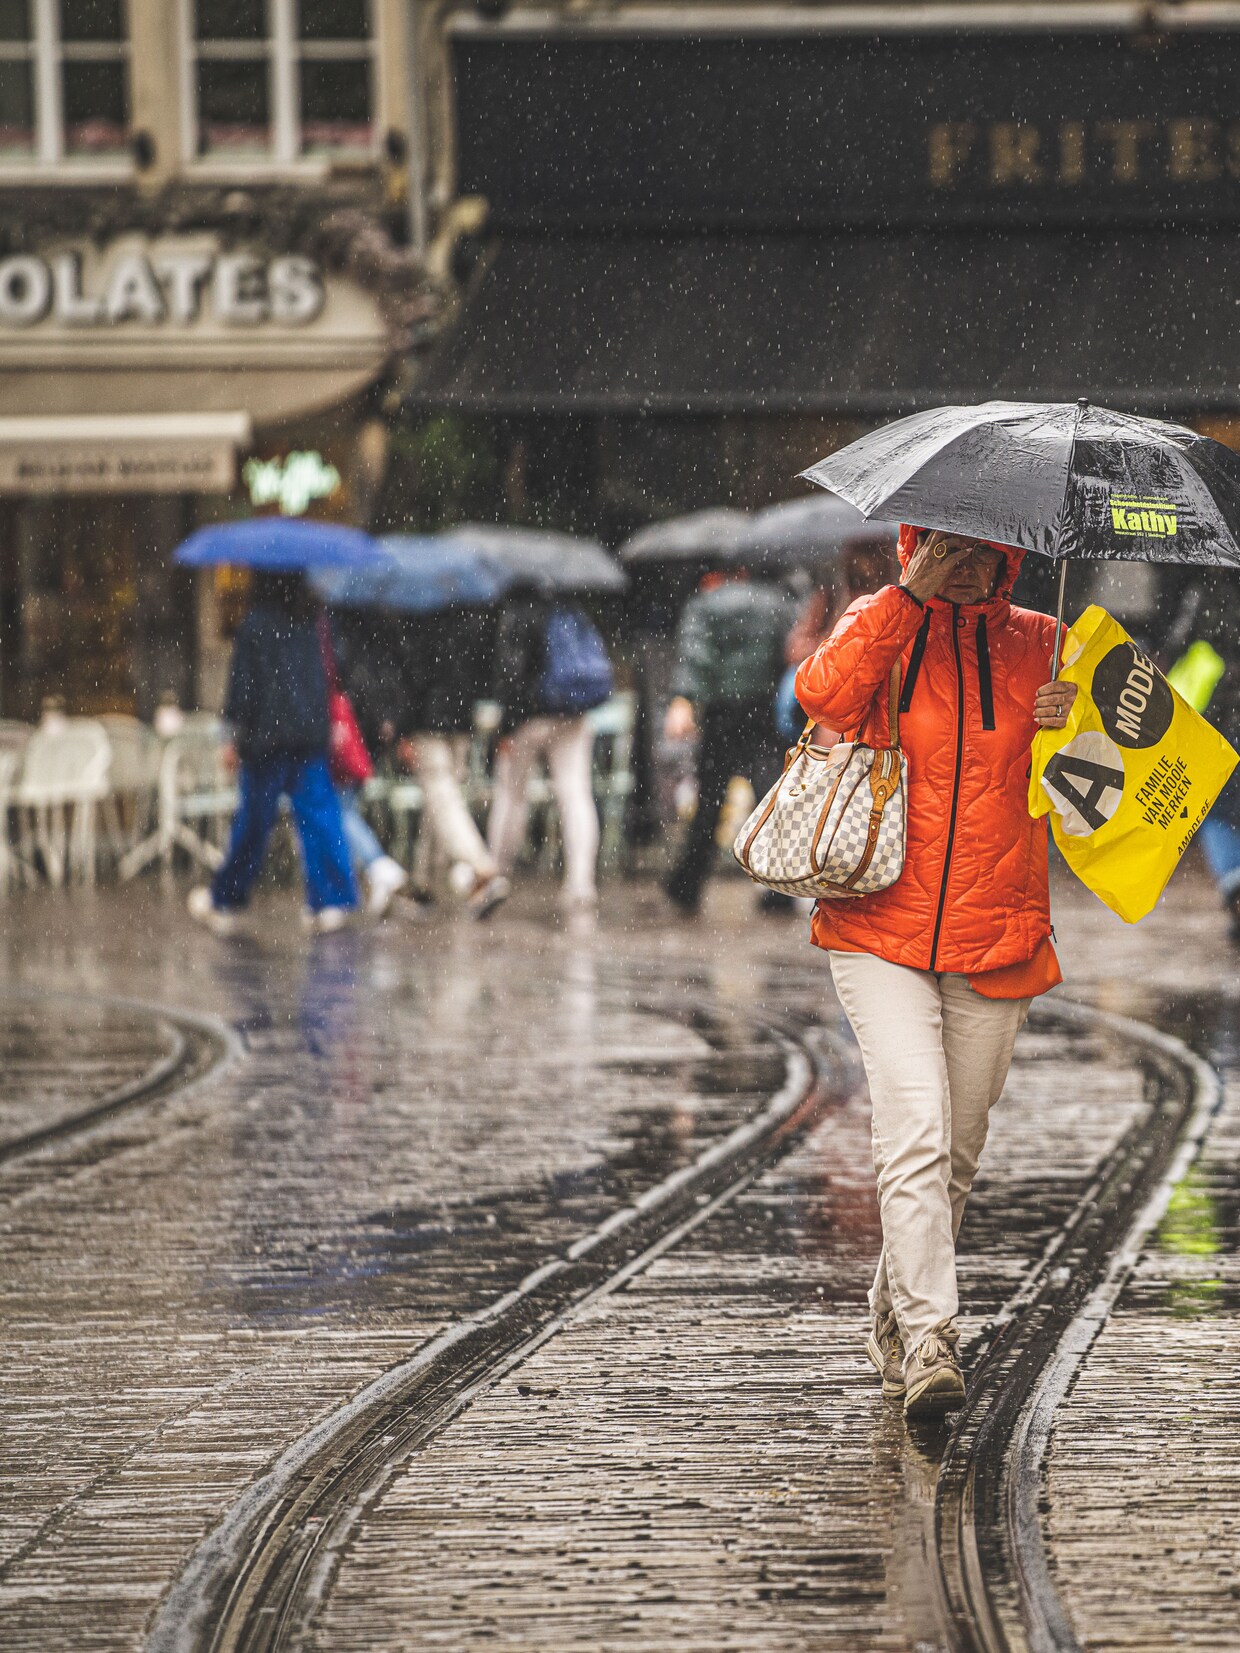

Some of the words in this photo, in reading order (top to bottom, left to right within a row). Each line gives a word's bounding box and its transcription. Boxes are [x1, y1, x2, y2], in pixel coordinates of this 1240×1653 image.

[0, 253, 324, 326] OLATES
[1111, 508, 1177, 536] Kathy
[1115, 649, 1155, 740] MODE
[1135, 755, 1173, 807] FAMILIE
[1142, 797, 1165, 825] VAN
[1159, 756, 1187, 800] MOOIE
[1157, 775, 1192, 830] MERKEN
